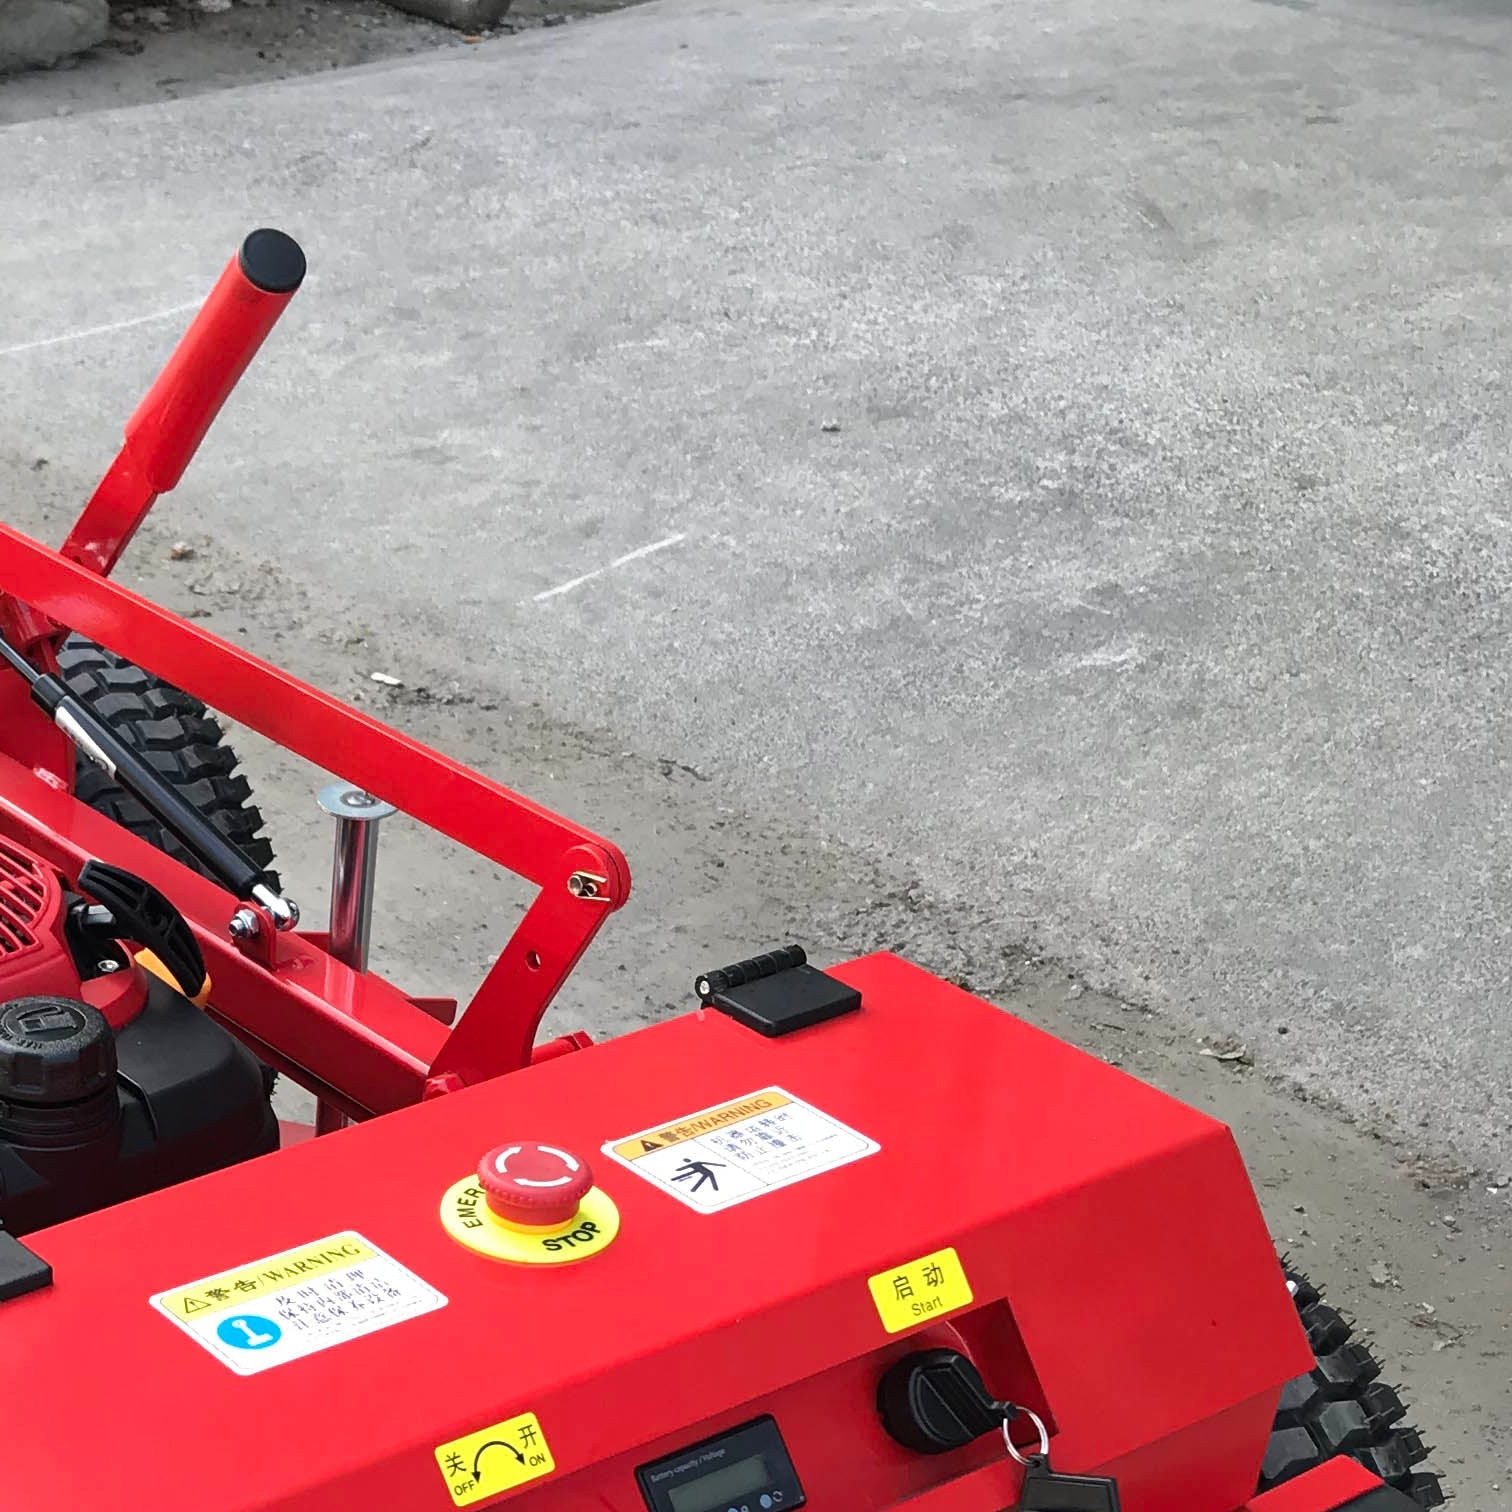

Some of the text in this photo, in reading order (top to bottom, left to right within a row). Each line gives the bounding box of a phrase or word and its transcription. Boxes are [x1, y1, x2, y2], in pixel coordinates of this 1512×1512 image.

[456, 1182, 487, 1229] EMER
[542, 1221, 601, 1251] STOP
[892, 1262, 945, 1301] 启动
[911, 1296, 943, 1316] Start
[517, 1424, 537, 1449] 开
[444, 1451, 467, 1477] 关
[529, 1452, 546, 1467] ON
[454, 1480, 475, 1496] OFF
